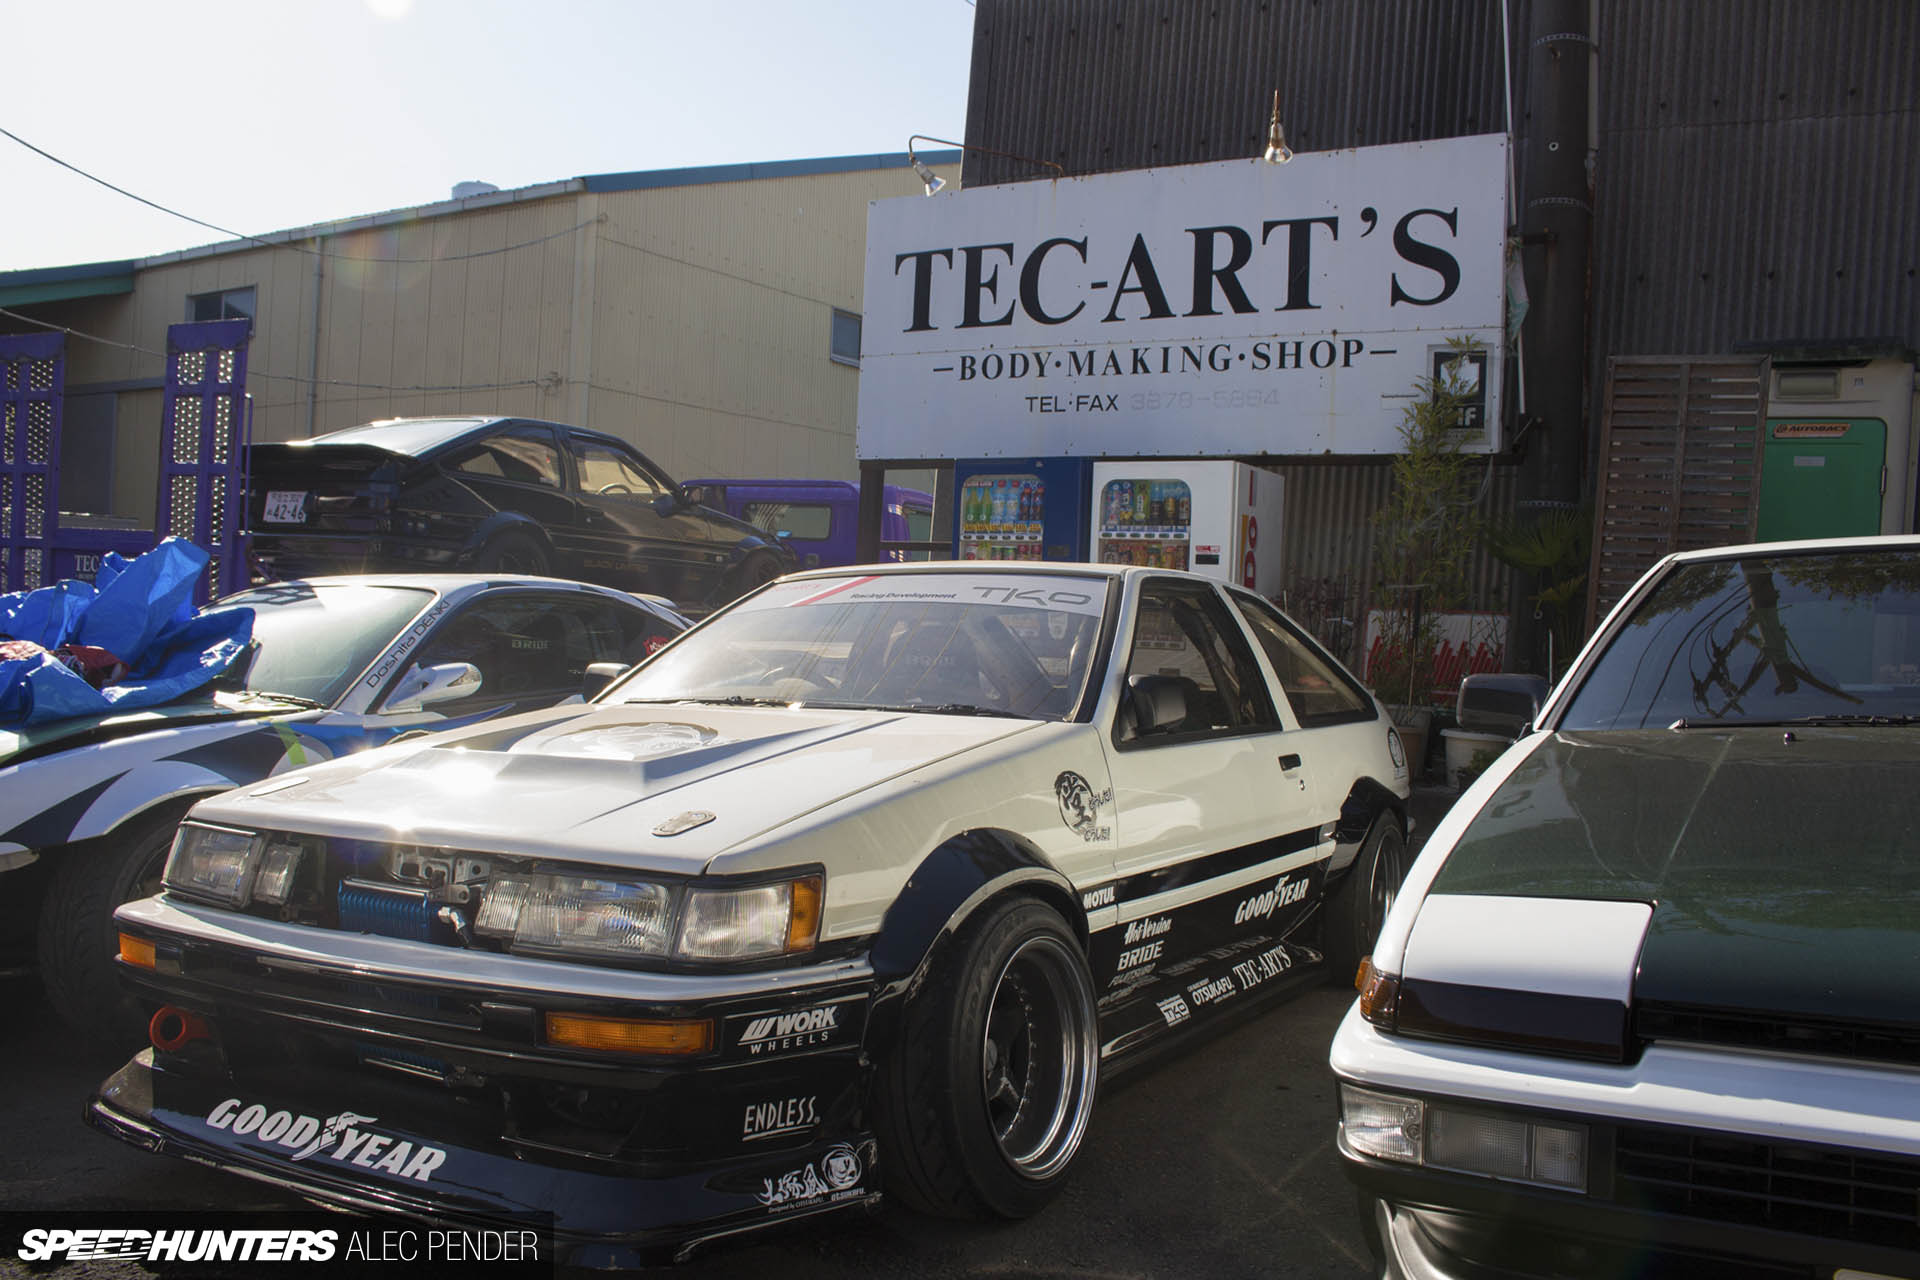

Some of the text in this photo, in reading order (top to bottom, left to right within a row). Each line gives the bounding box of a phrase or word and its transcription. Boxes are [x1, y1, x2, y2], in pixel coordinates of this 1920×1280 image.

[894, 206, 1461, 333] TEC-ART'S
[886, 591, 958, 601] Development
[972, 584, 1092, 606] TKO
[1083, 886, 1116, 910] MOTUL
[1117, 940, 1165, 972] BRIDE
[775, 1005, 838, 1037] WORK
[1163, 1002, 1187, 1019] TKO
[751, 1030, 829, 1055] WHEELS
